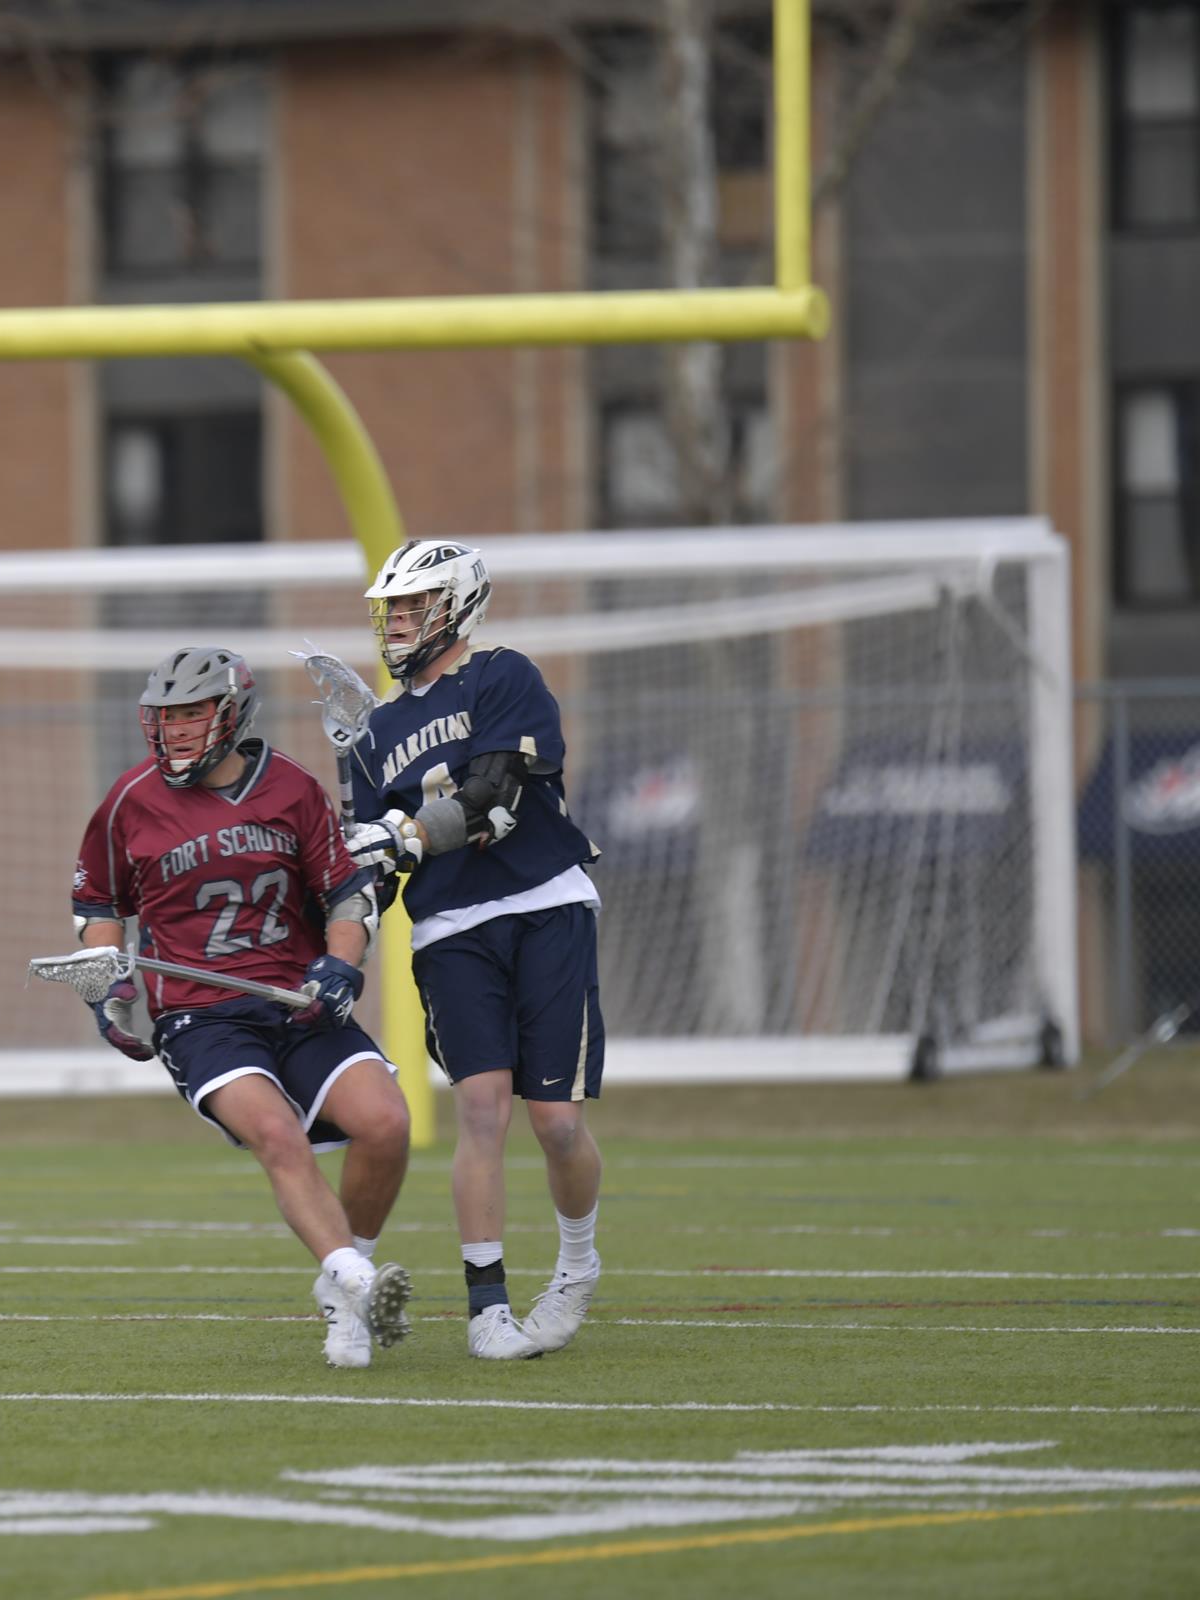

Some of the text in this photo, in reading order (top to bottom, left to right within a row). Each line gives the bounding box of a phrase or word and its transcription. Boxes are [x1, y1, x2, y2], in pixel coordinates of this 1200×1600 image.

[381, 711, 472, 790] MARITIM
[159, 834, 209, 883] FORT
[195, 867, 290, 958] 22
